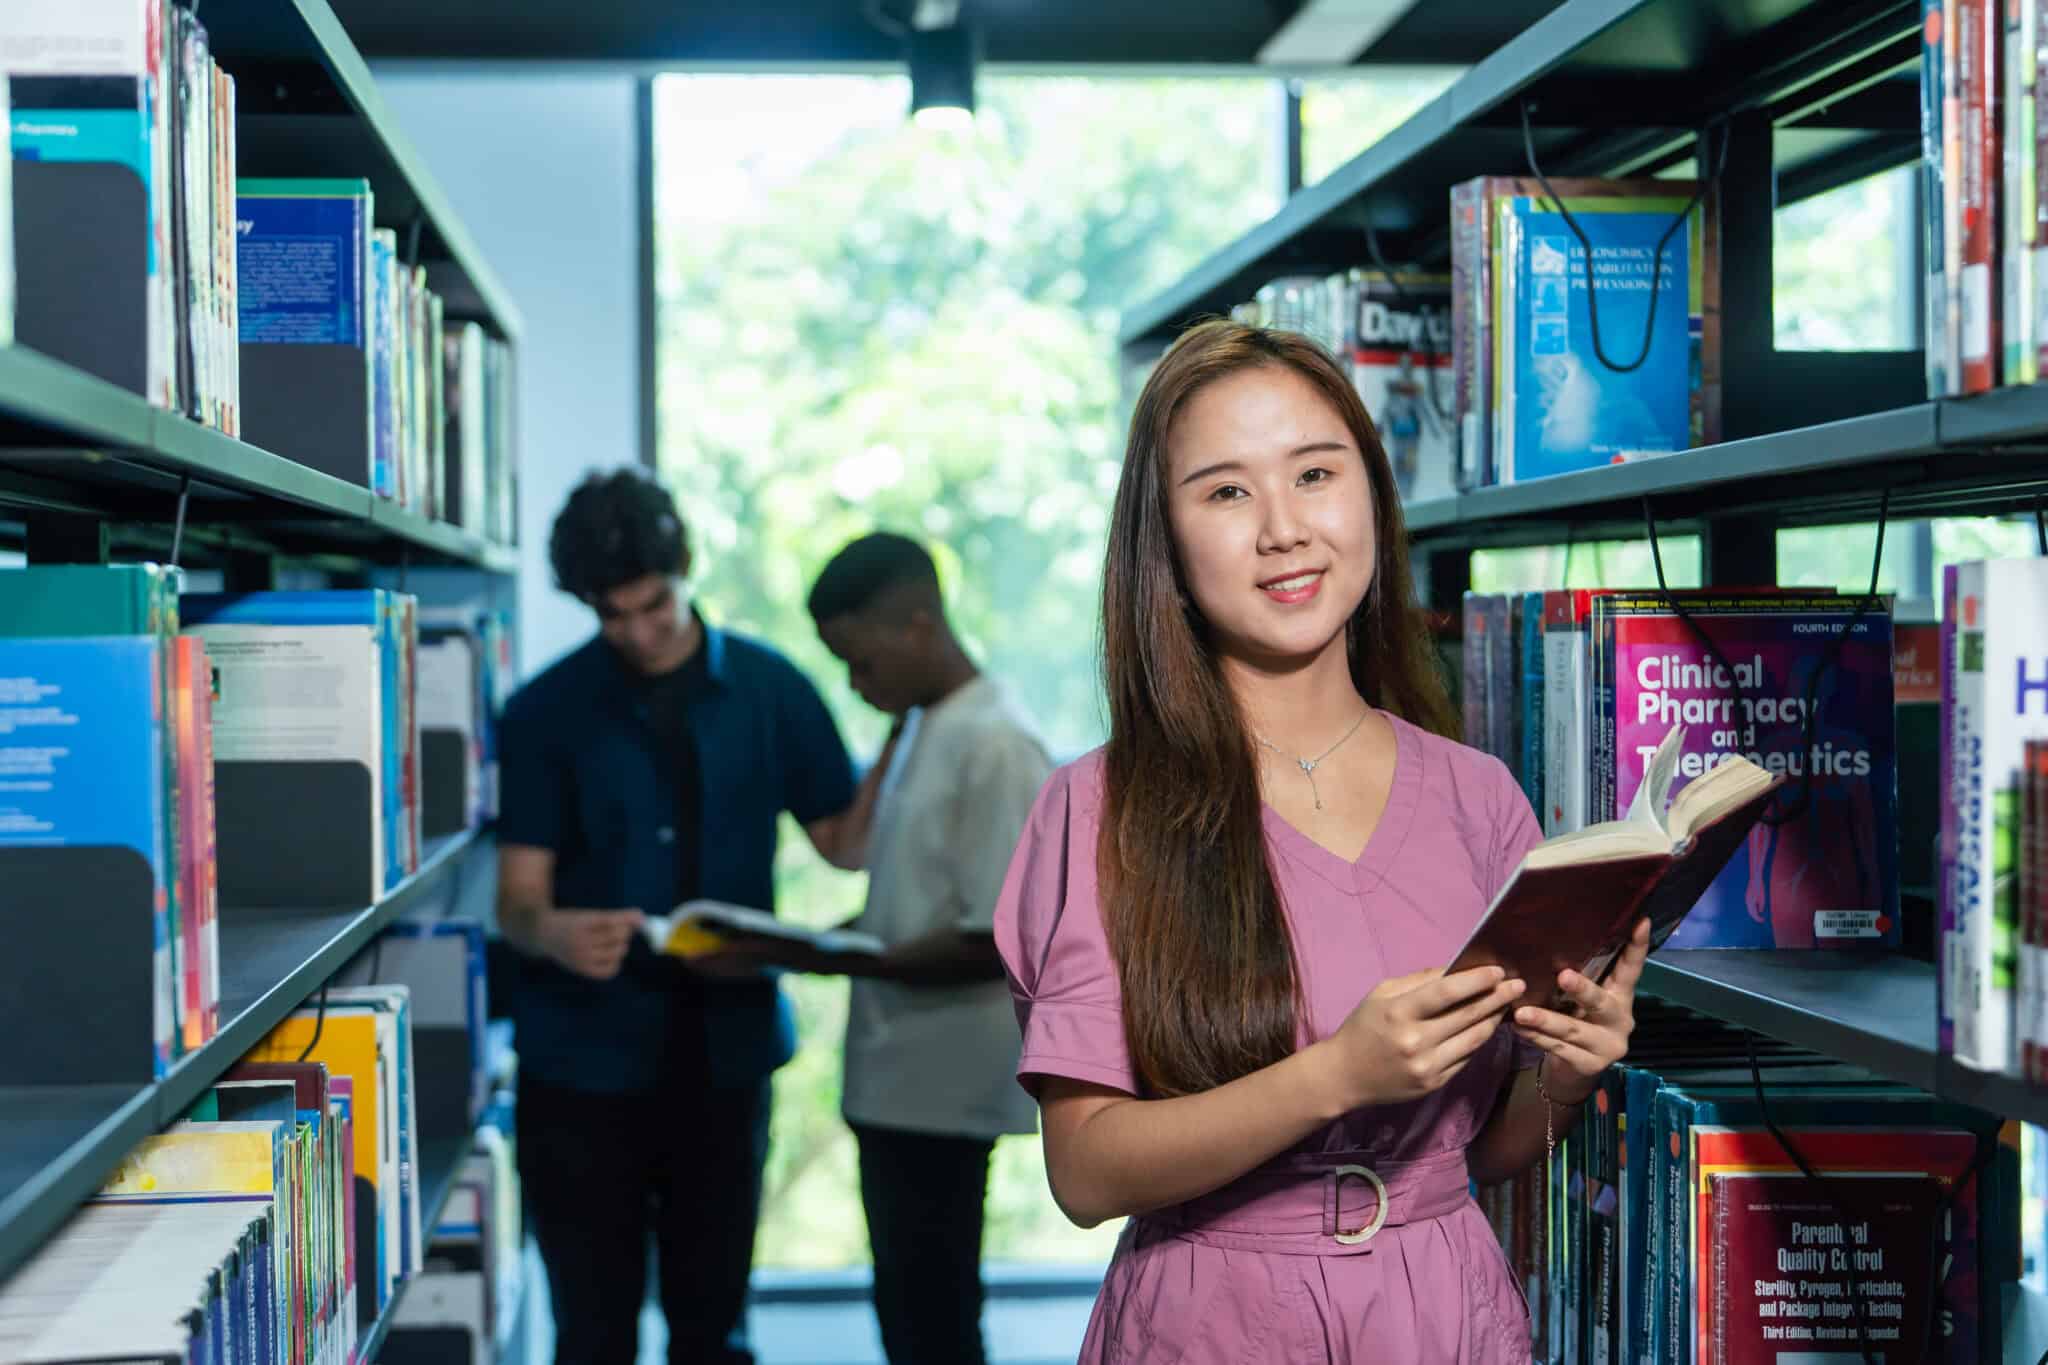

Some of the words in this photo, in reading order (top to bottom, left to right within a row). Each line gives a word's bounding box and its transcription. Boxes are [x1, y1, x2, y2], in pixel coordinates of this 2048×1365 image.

[1570, 247, 1654, 257] ERONOMICS
[1571, 279, 1672, 289] PRFESSIONLS
[1793, 623, 1829, 633] FOURTH
[1831, 623, 1868, 633] EDON
[1637, 655, 1763, 690] Clinical
[1638, 690, 1819, 732] Pharmacy
[1712, 725, 1755, 747] and
[1636, 743, 1871, 777] Tereutics
[1791, 1221, 1868, 1245] Parental
[1777, 1247, 1827, 1274] Quality
[1754, 1279, 1797, 1298] Sterility,
[1799, 1279, 1845, 1298] Pyrogen,
[1847, 1279, 1907, 1298] rticulate,
[1759, 1300, 1777, 1317] and
[1779, 1300, 1820, 1319] Package
[1823, 1300, 1866, 1319] Integr
[1868, 1300, 1904, 1319] Testing
[1762, 1326, 1784, 1340] Third
[1815, 1326, 1847, 1340] Revised
[1847, 1327, 1860, 1340] an
